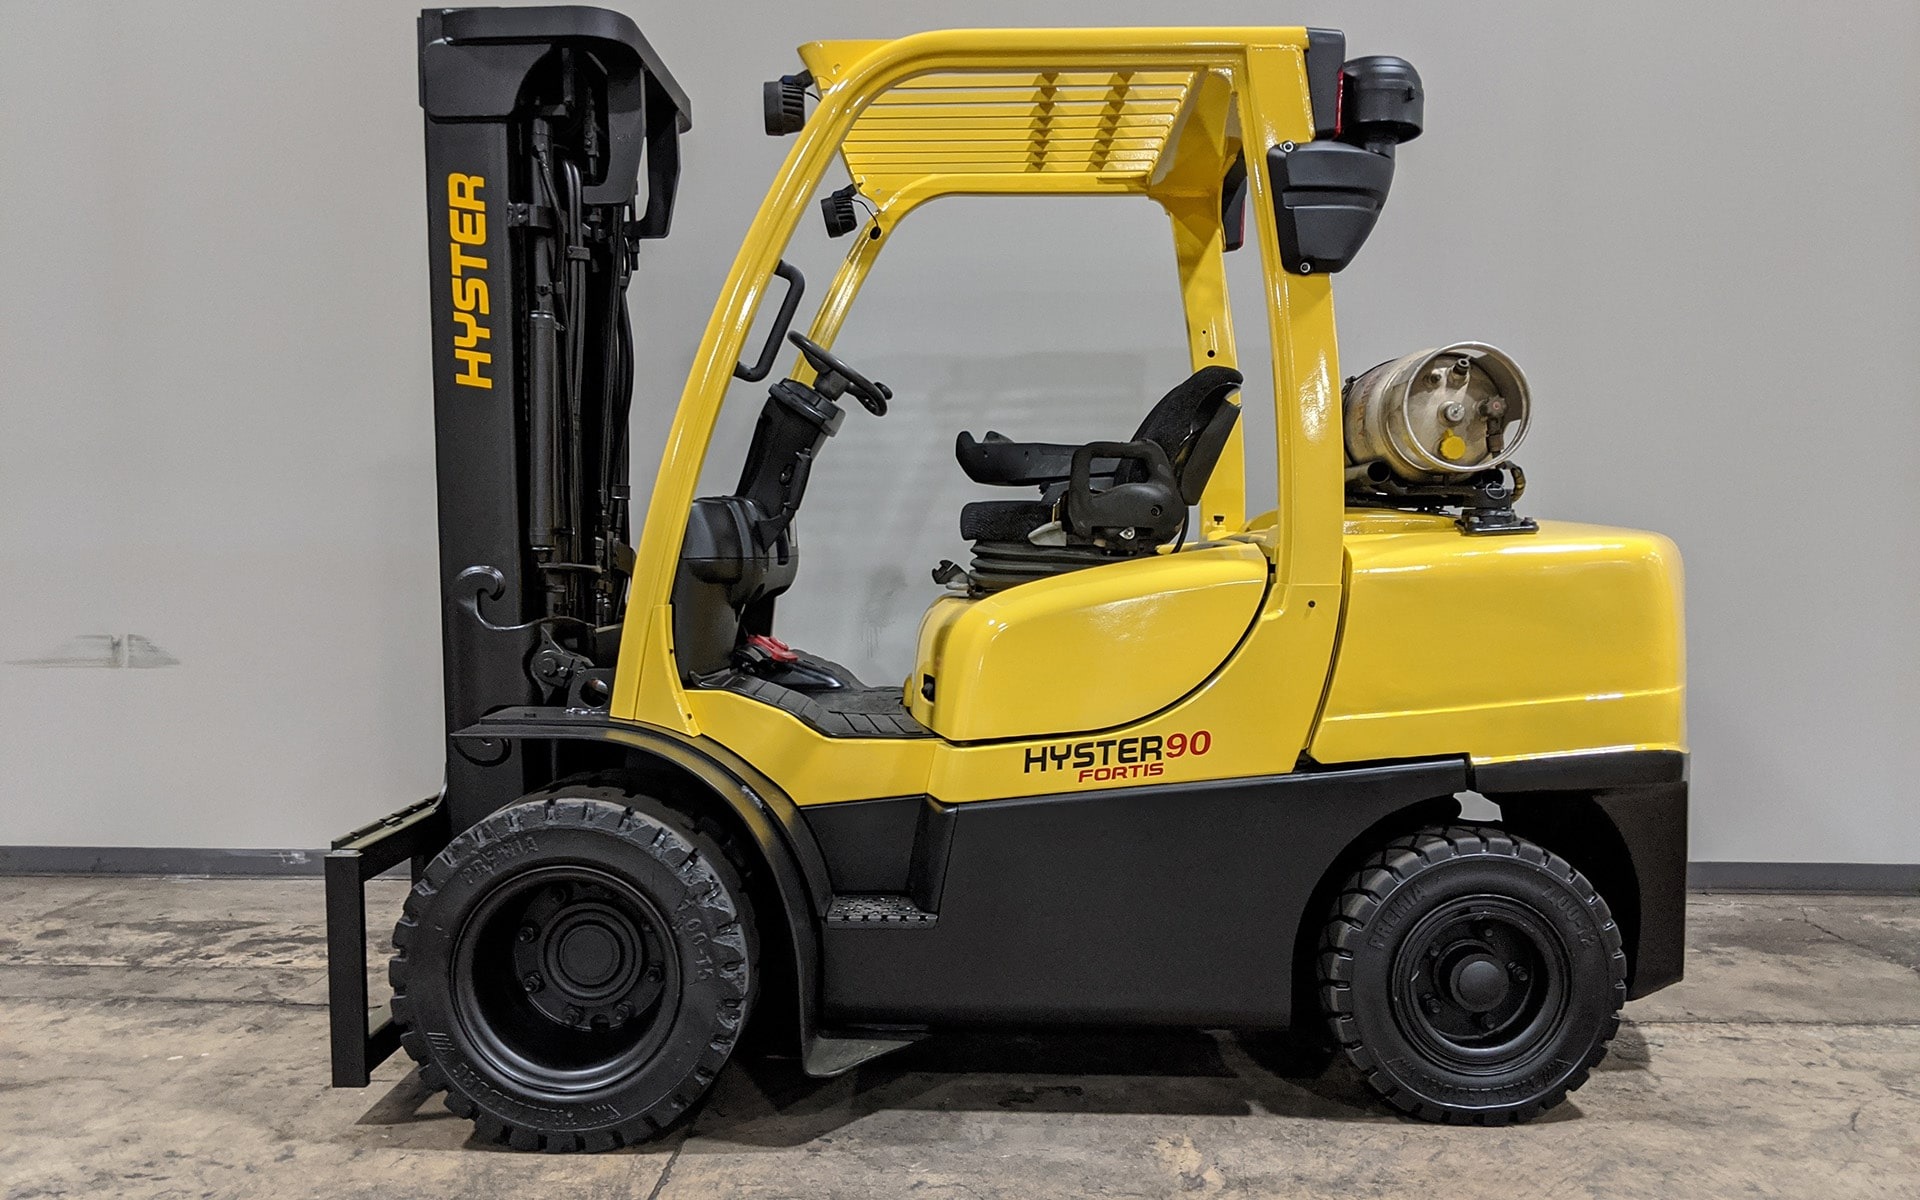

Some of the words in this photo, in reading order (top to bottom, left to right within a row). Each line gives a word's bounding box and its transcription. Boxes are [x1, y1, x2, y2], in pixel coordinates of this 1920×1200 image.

[448, 172, 493, 389] HYSTER
[1024, 736, 1163, 773] HYSTER
[1166, 730, 1212, 758] 90
[1078, 763, 1164, 782] FORTIS
